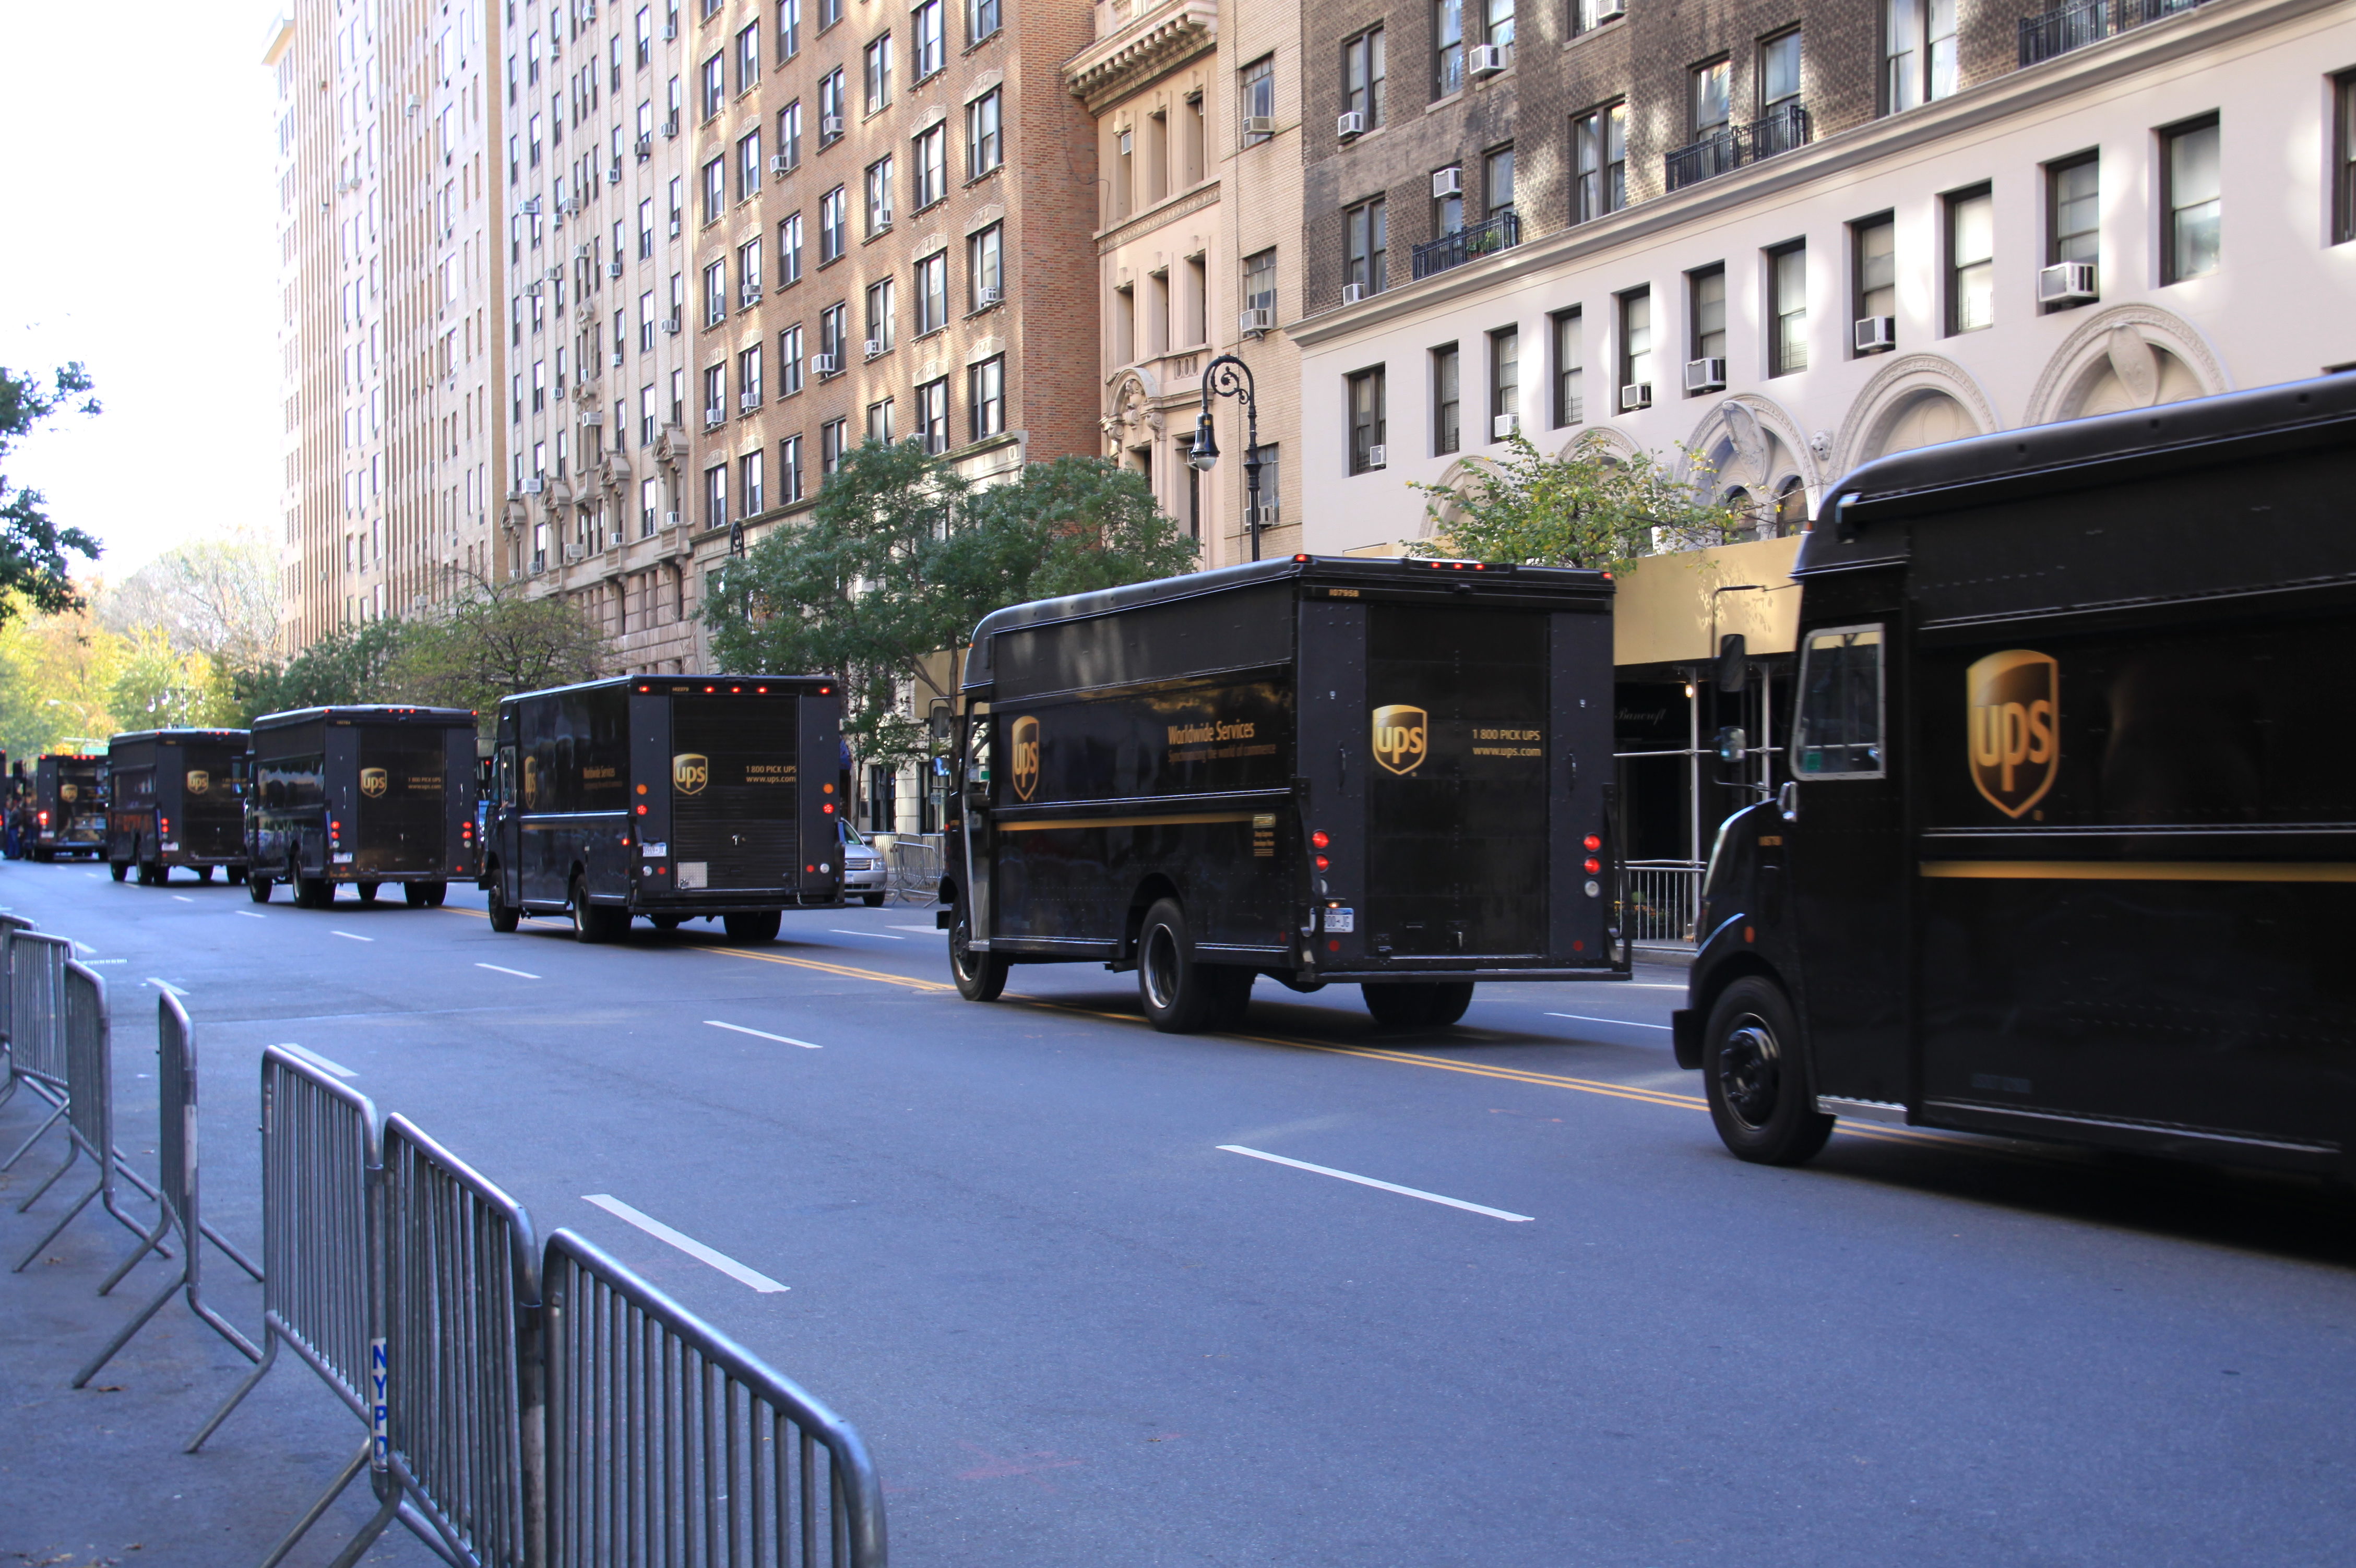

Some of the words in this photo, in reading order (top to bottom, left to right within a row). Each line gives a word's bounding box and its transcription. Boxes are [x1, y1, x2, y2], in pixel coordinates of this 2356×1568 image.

[1168, 722, 1215, 745] Worldwide
[1216, 719, 1255, 740] Services
[1378, 726, 1423, 764] ups
[1472, 729, 1478, 739] 1
[1480, 729, 1498, 739] 800
[1500, 730, 1521, 740] PICK
[1522, 731, 1541, 740] UPS
[1472, 747, 1541, 759] www.ups.com
[1975, 700, 2052, 792] ups
[675, 766, 705, 789] ups
[1013, 741, 1037, 789] ups
[190, 777, 207, 791] ups
[363, 777, 385, 793] ups
[525, 772, 536, 801] ups
[372, 1345, 387, 1461] NYPD
